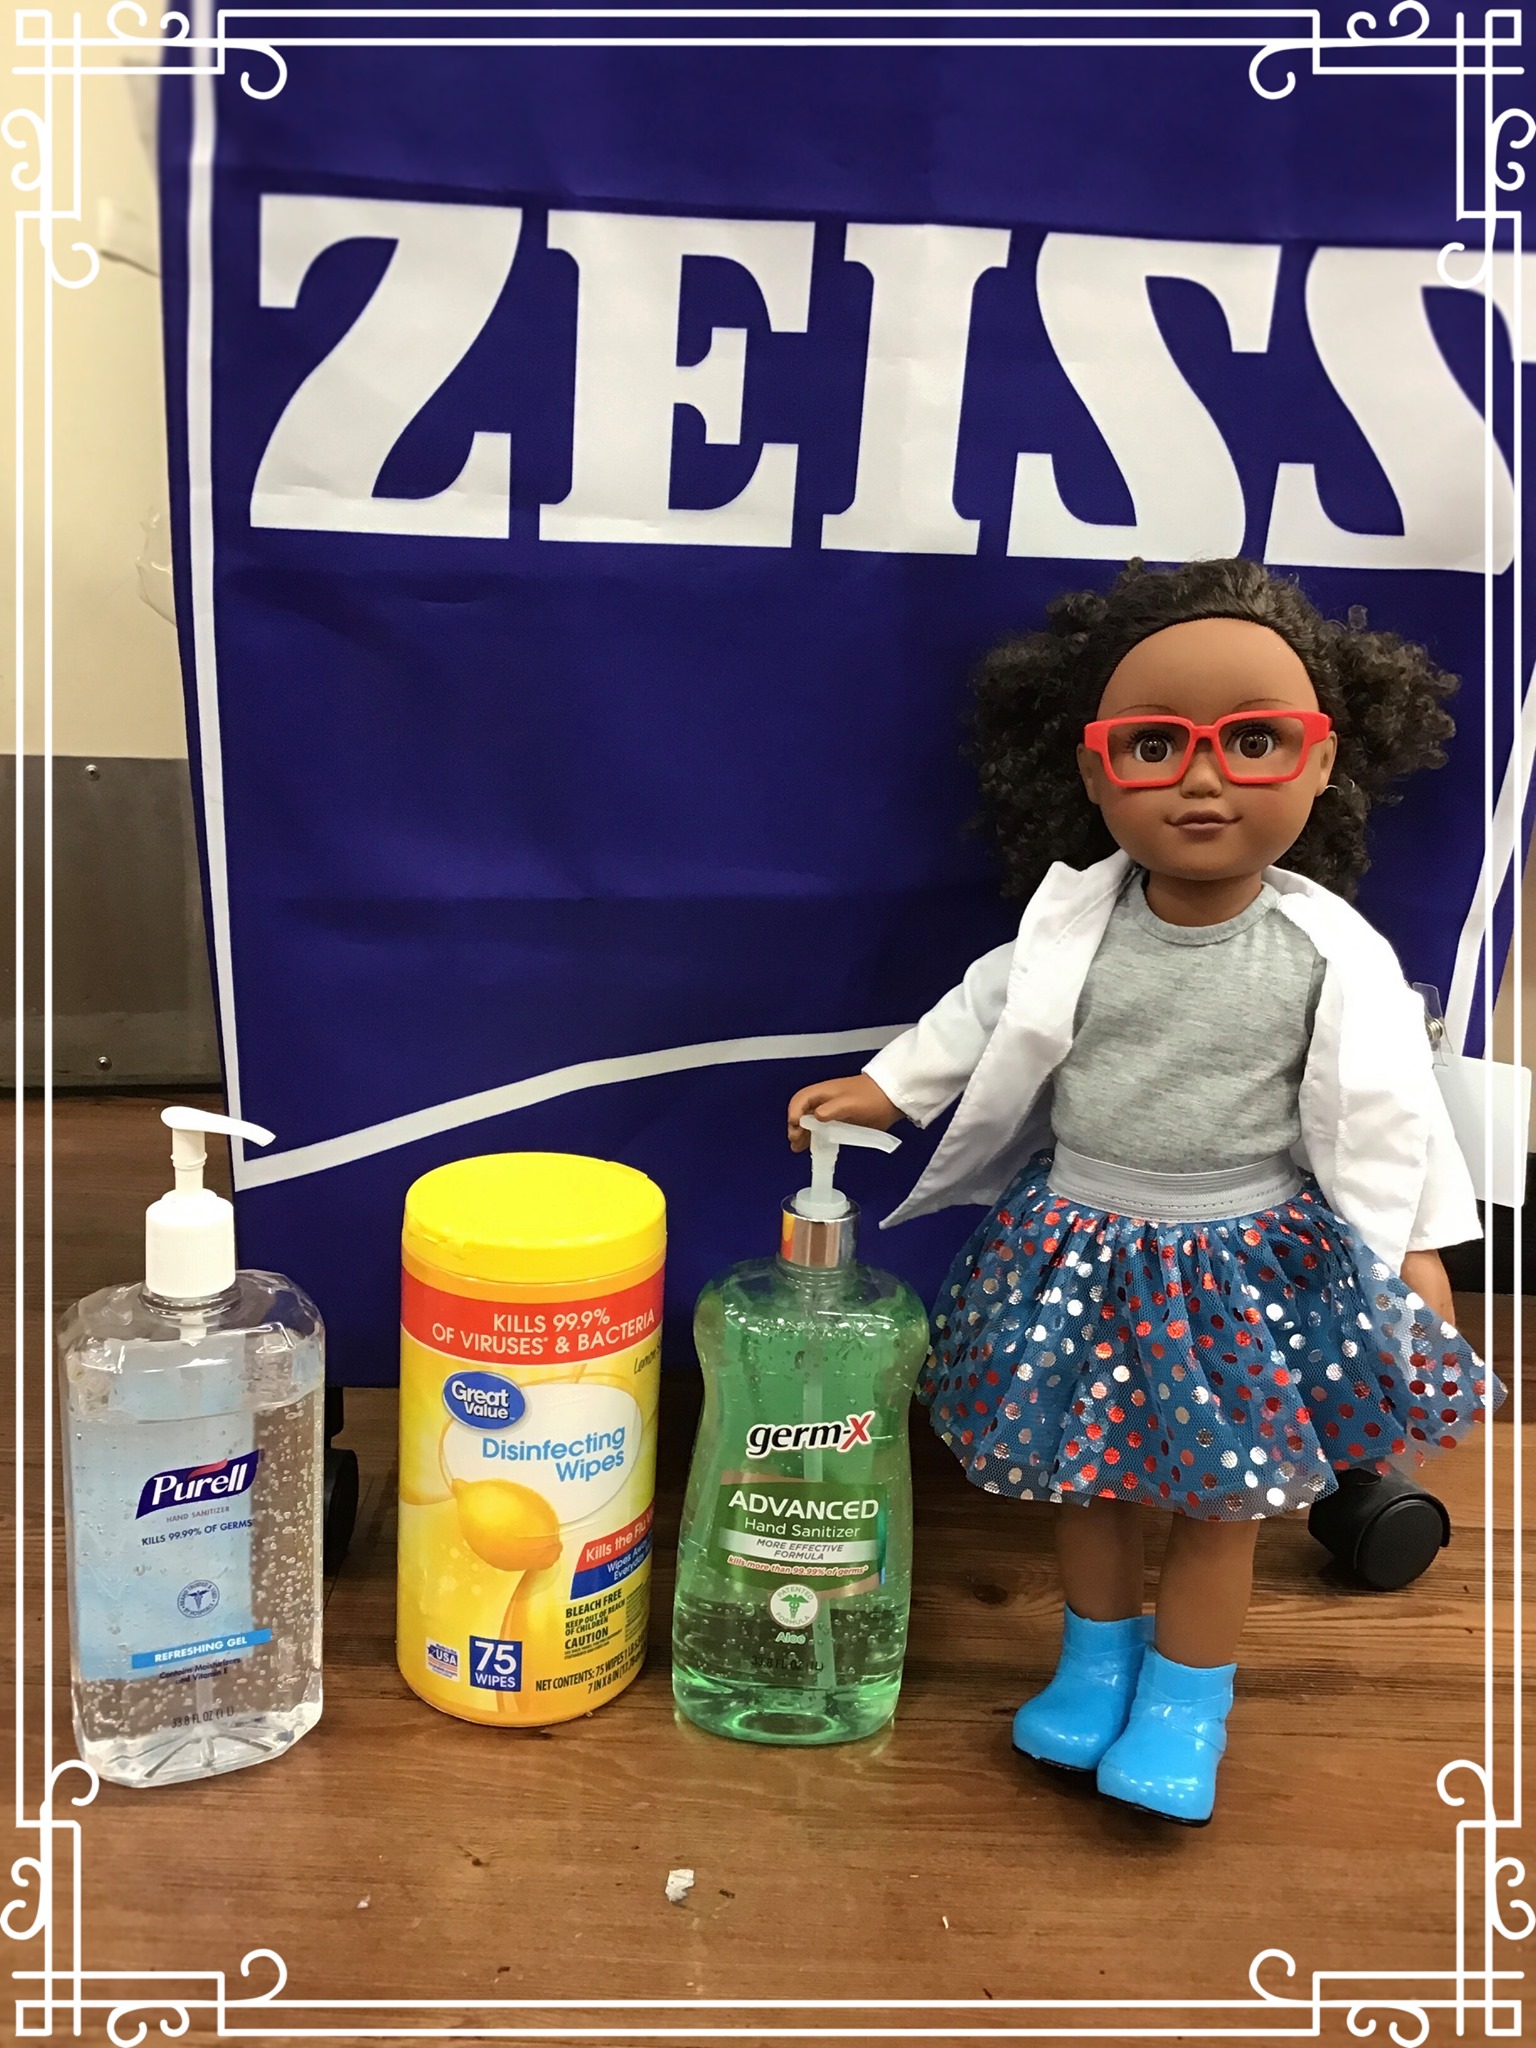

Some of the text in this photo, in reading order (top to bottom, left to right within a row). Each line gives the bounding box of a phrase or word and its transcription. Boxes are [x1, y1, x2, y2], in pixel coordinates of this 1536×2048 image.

[249, 193, 1536, 574] ZEISS
[432, 1322, 455, 1344] OF
[554, 1336, 570, 1354] &
[577, 1308, 655, 1350] BACTERIA
[493, 1307, 611, 1333] KILLS 99.9%
[451, 1380, 509, 1407] Great
[464, 1401, 509, 1420] Value
[482, 1426, 626, 1461] Disinfecting
[555, 1450, 625, 1482] Wipes
[152, 1463, 248, 1506] Purell
[166, 1506, 230, 1523] HAND SANITIZER
[728, 1490, 879, 1520] ADVANCED
[141, 1534, 166, 1546] KILLS
[168, 1528, 202, 1541] 99.99%
[204, 1524, 218, 1534] OF
[745, 1517, 861, 1538] Hand Sanitizer
[586, 1543, 612, 1563] Kills
[615, 1532, 633, 1551] the
[756, 1538, 844, 1552] MORE EFFECTIVE
[774, 1550, 824, 1560] FORMULA
[606, 1554, 632, 1573] Wipes
[727, 1555, 746, 1567] kills
[747, 1560, 769, 1571] more
[771, 1564, 791, 1574] than
[792, 1566, 825, 1576] 99.99%
[826, 1566, 838, 1576] of
[565, 1588, 622, 1618] BLEACH FREE
[776, 1586, 814, 1601] PATENTED
[565, 1598, 626, 1629] KEEP OUT OF REACH
[565, 1616, 609, 1637] OF CHILDREN
[565, 1626, 609, 1650] CAUTION
[154, 1636, 248, 1663] REFRESHING GEL
[435, 1649, 457, 1666] USA
[474, 1640, 517, 1675] 75
[159, 1657, 241, 1680] Contains Moisturizers
[192, 1670, 222, 1681] Vitamin
[475, 1672, 516, 1688] WIPES
[536, 1679, 552, 1692] NET
[595, 1662, 605, 1677] 75
[605, 1651, 624, 1672] WIPES
[593, 1680, 601, 1692] IN
[171, 1715, 190, 1728] 33.8
[192, 1713, 201, 1723] FL
[202, 1710, 213, 1721] OZ
